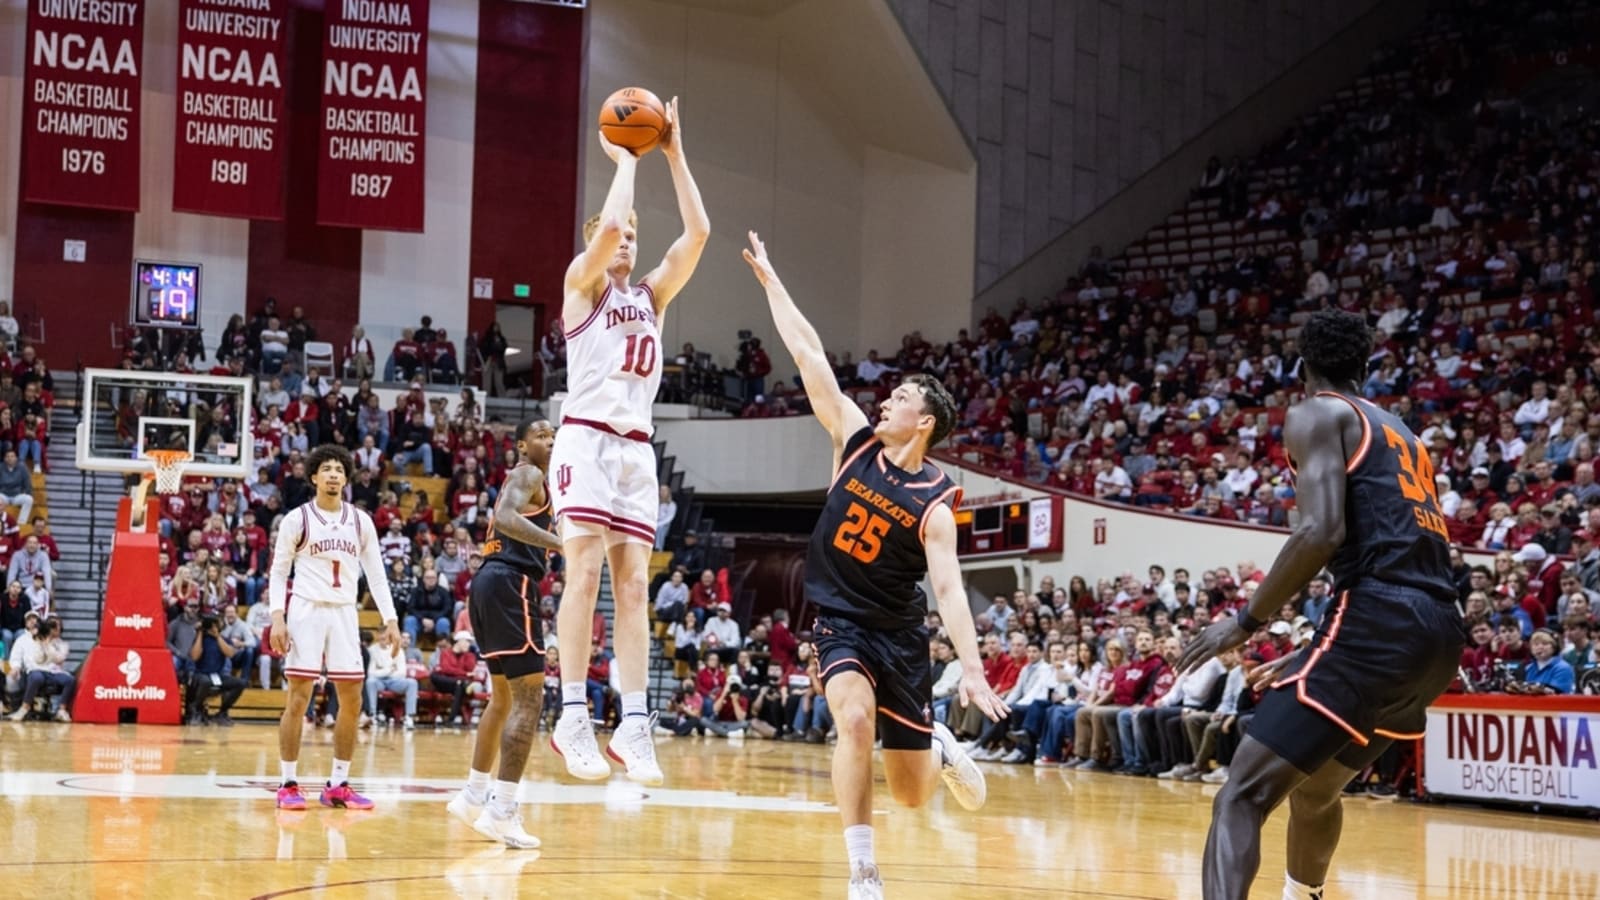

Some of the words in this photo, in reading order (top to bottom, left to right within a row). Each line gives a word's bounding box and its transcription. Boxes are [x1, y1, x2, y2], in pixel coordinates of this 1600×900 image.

[38, 0, 137, 27] UNIVERSITY
[186, 8, 281, 41] UNIVERSITY
[342, 0, 412, 26] INDIANA
[33, 30, 137, 76] NCAA
[329, 26, 422, 54] UNIVERSITY
[182, 44, 282, 88] NCAA
[324, 59, 423, 102] NCAA
[34, 79, 132, 113] BASKETBALL
[183, 92, 278, 123] BASKETBALL
[37, 109, 128, 141] CHAMPIONS
[186, 121, 273, 151] CHAMPIONS
[325, 108, 419, 137] BASKETBALL
[62, 148, 106, 175] 1976
[329, 137, 415, 165] CHAMPIONS
[211, 160, 247, 185] 1981
[351, 174, 392, 198] 1987
[153, 269, 193, 288] 4:14
[158, 289, 187, 320] 19
[621, 334, 656, 378] 10
[1382, 424, 1445, 520] 34
[844, 478, 917, 528] BEARKATS
[310, 539, 357, 557] INDIANA
[832, 502, 892, 564] 25
[332, 560, 341, 588] 1
[115, 614, 153, 630] meijer
[94, 686, 166, 700] Smithville
[1447, 712, 1597, 769] INDIANA
[1462, 764, 1579, 799] BASKETBALL
